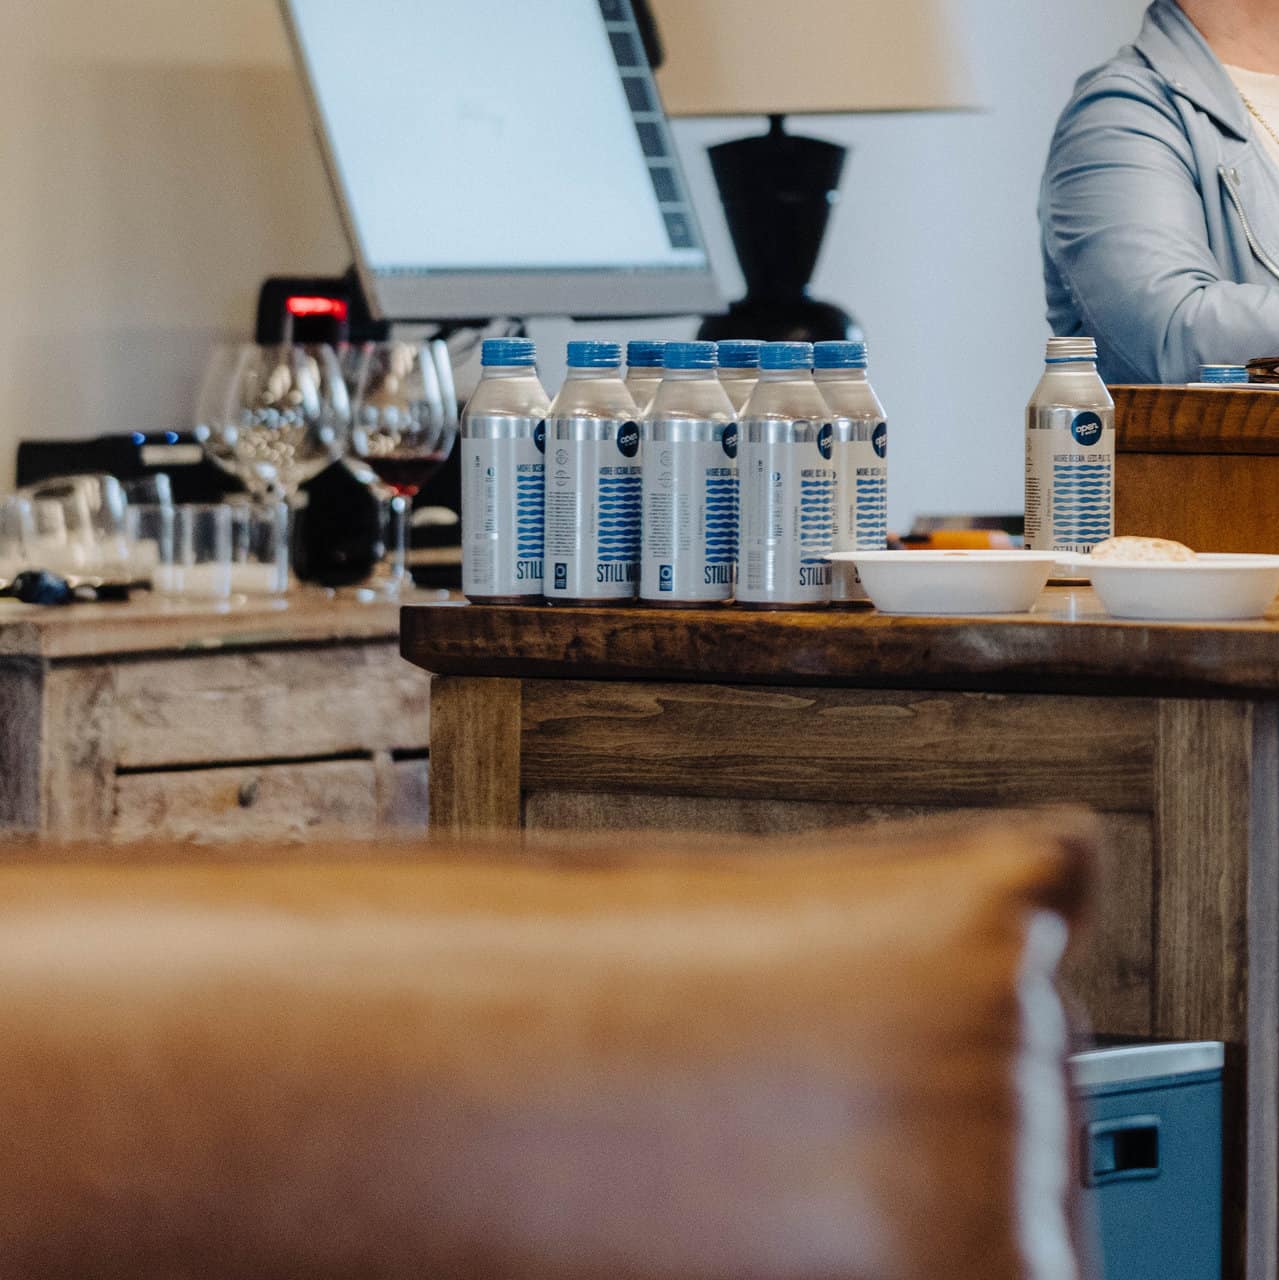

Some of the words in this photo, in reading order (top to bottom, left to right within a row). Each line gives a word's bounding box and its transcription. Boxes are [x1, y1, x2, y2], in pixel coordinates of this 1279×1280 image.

[517, 561, 544, 579] STILL
[597, 564, 624, 582] STILL
[705, 565, 728, 584] STILL
[800, 567, 824, 586] STILL
